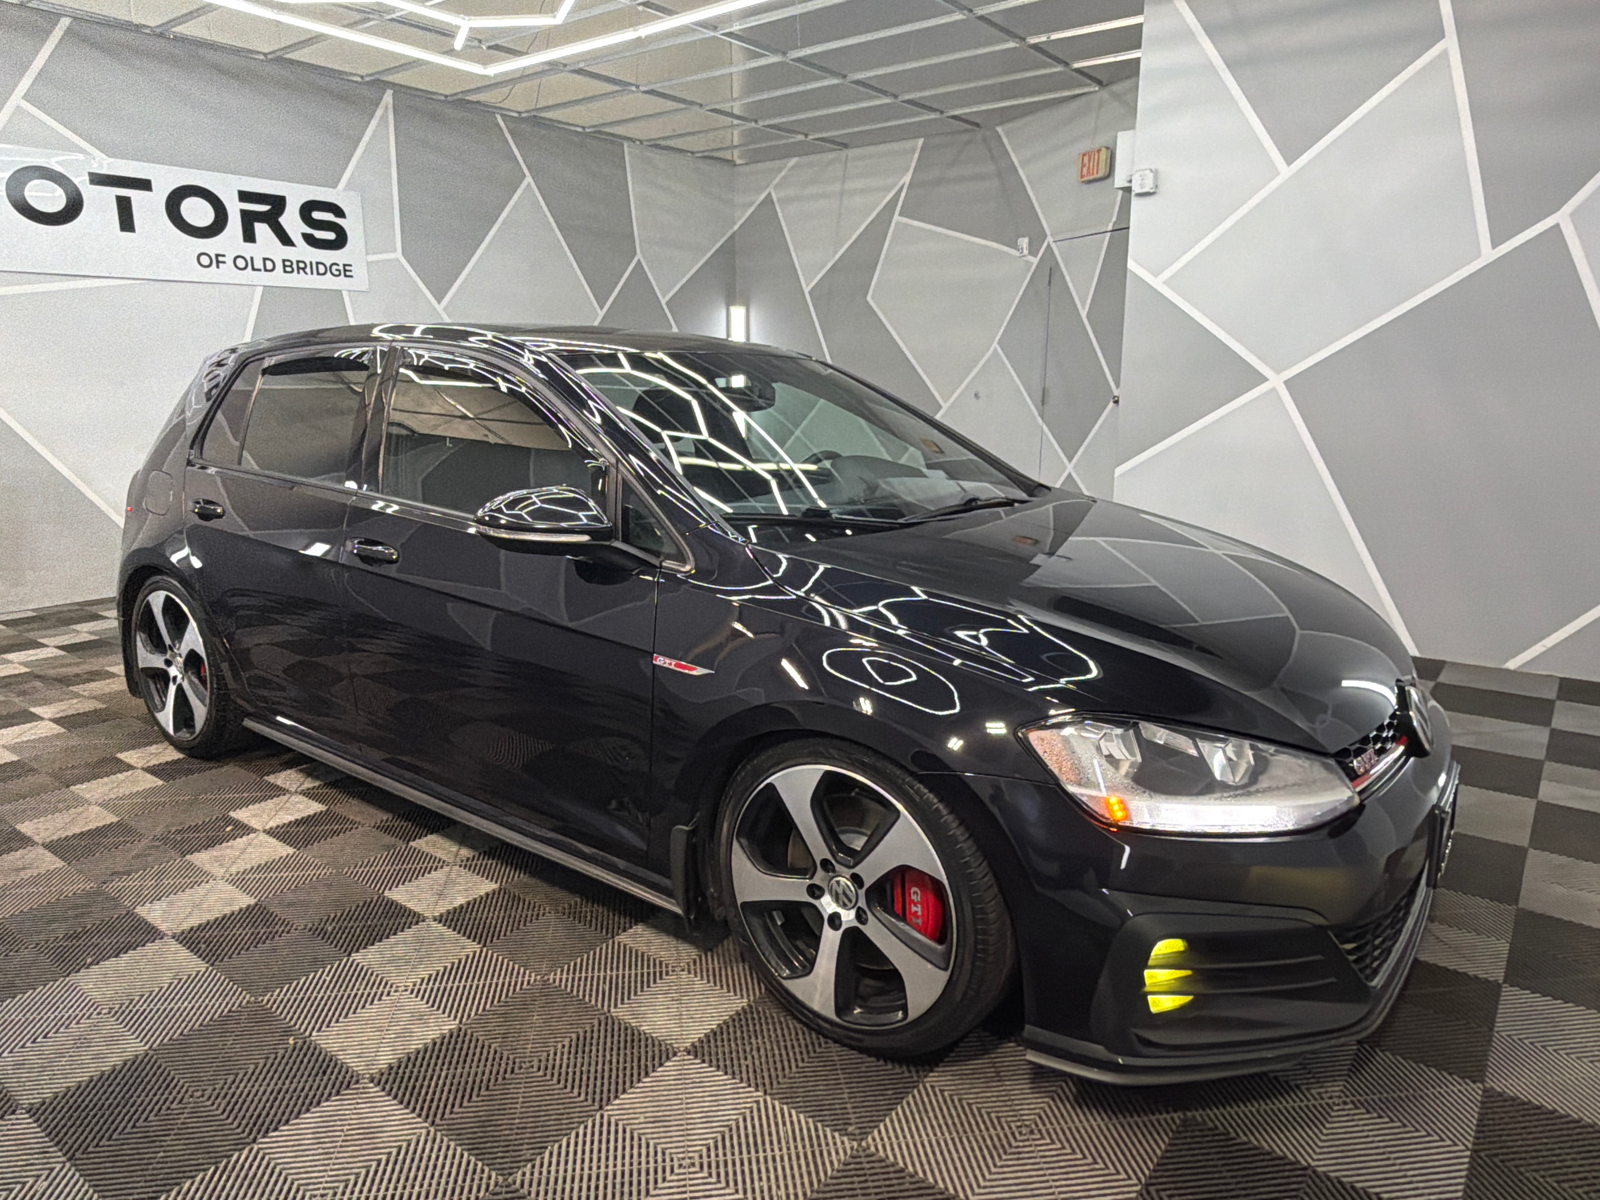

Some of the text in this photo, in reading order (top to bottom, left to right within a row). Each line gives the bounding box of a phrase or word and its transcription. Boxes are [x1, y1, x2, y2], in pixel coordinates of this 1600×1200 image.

[1080, 149, 1102, 179] EXIT
[5, 165, 348, 251] OTORS
[196, 252, 354, 278] OF OLD BRIDGE
[910, 886, 922, 926] GTI
